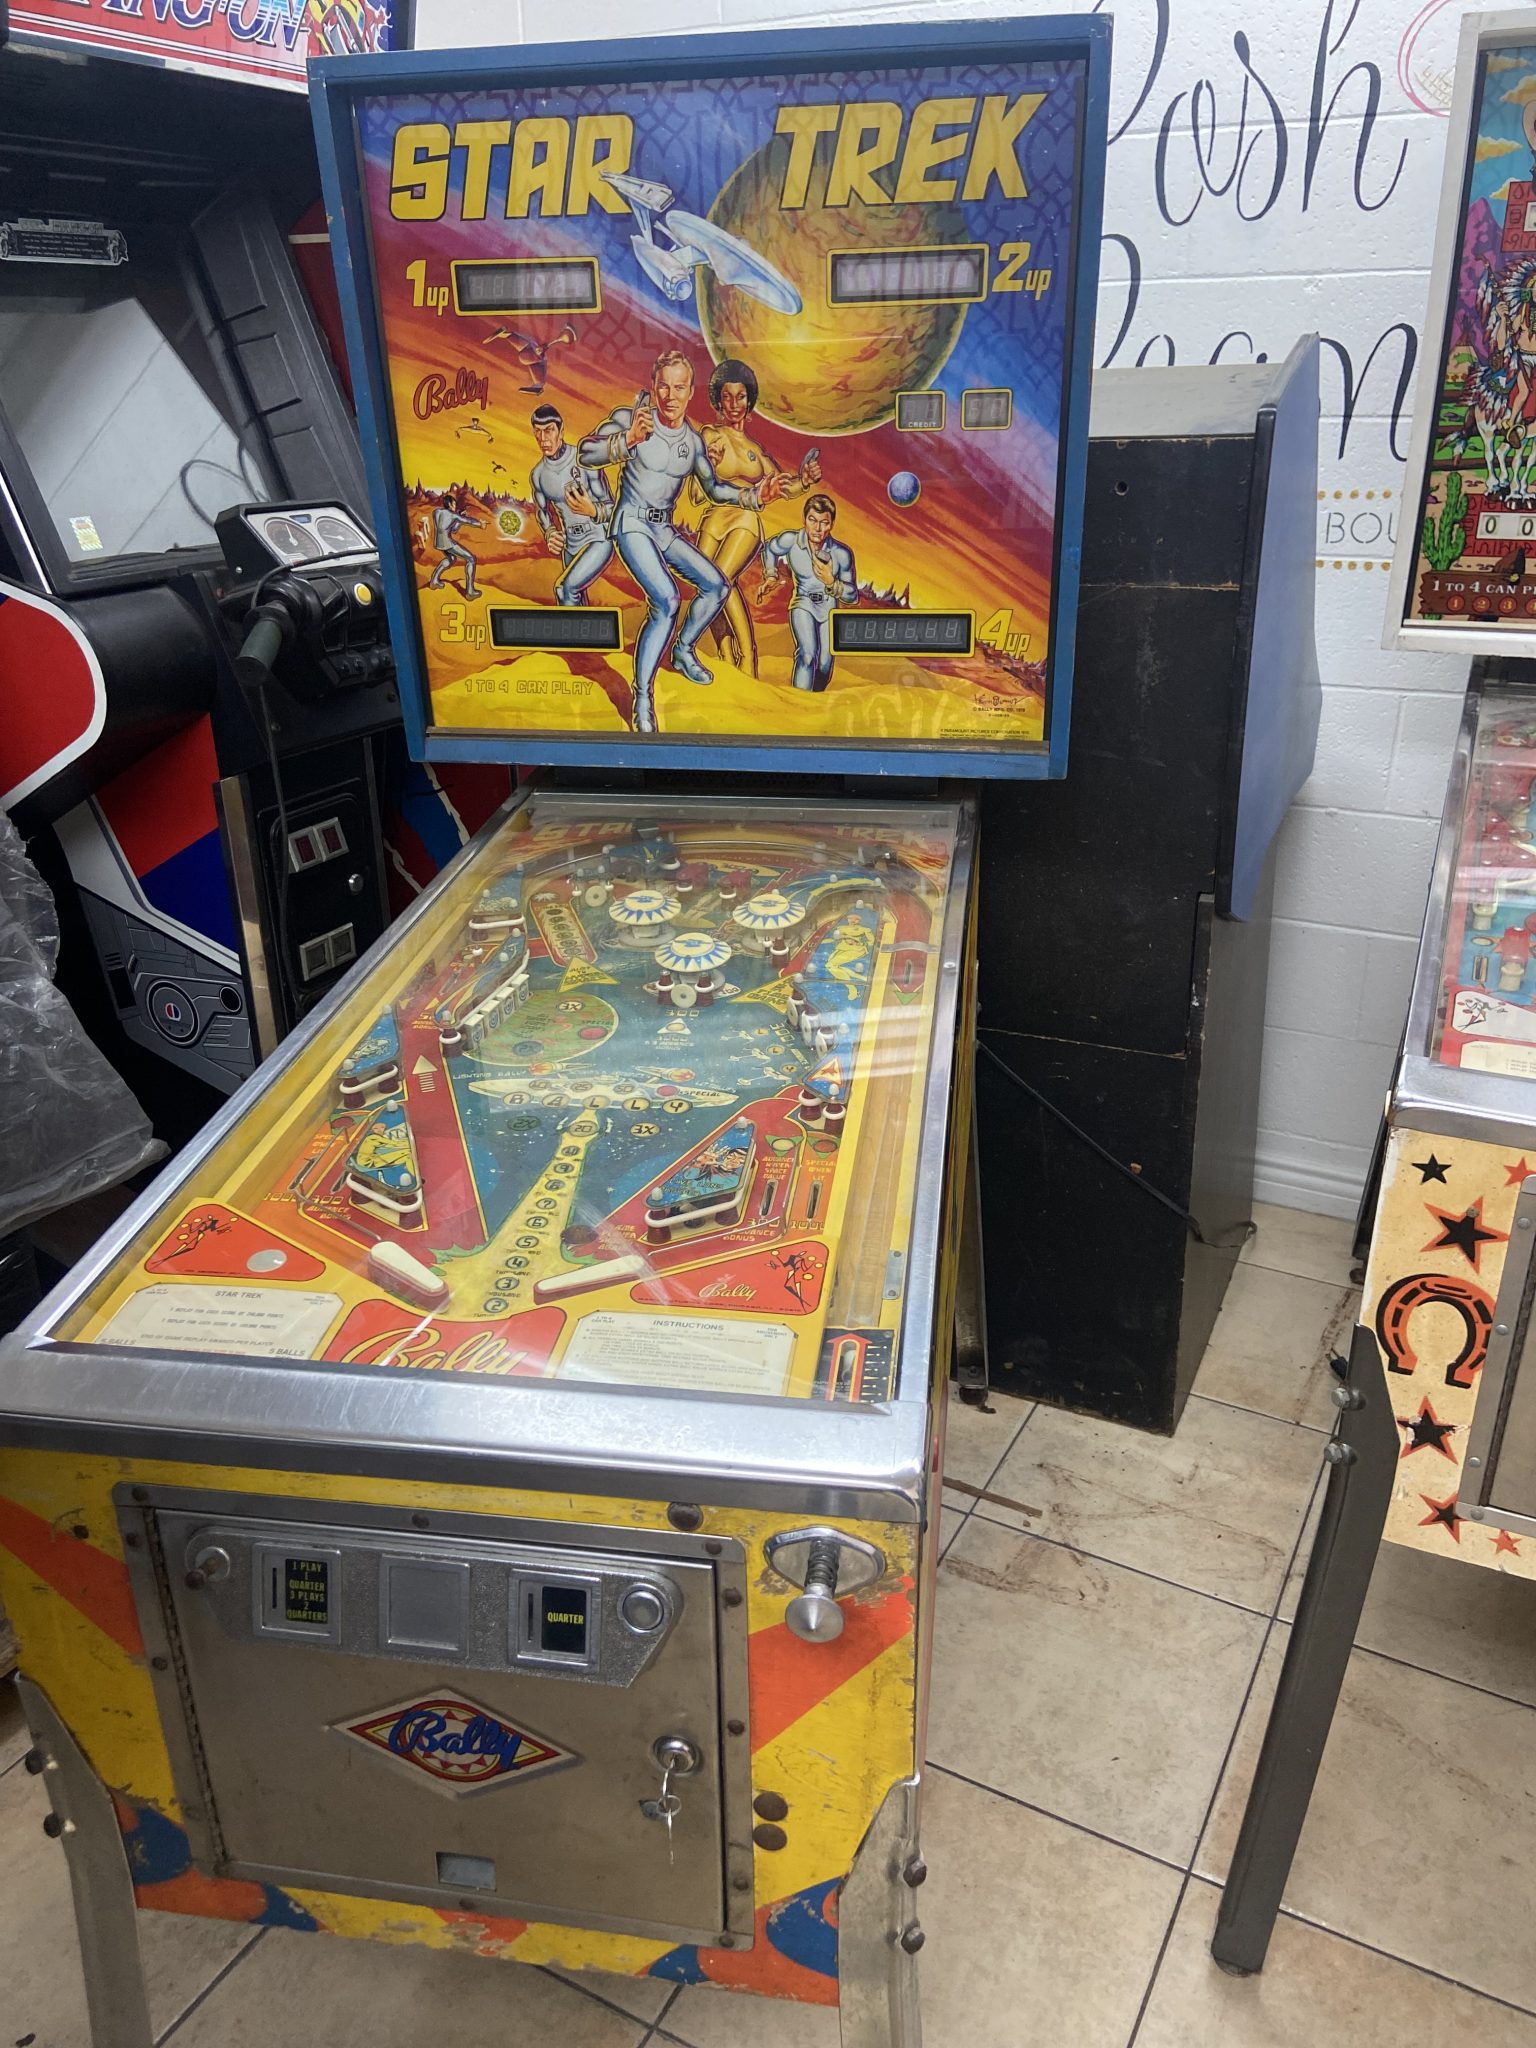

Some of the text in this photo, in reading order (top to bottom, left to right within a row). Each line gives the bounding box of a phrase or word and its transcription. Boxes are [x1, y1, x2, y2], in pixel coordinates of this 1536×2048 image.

[389, 93, 1048, 221] STAR TREK
[413, 367, 489, 420] Bally
[1432, 580, 1440, 591] 1
[1445, 582, 1465, 592] TO
[1469, 580, 1480, 592] 4
[1486, 584, 1518, 594] CAN
[465, 679, 593, 695] 1 TO 4 CAN PLAY
[833, 824, 929, 849] TREK
[633, 1125, 655, 1134] 3X
[215, 1290, 264, 1300] STAR TREK
[699, 1282, 758, 1301] Bally
[653, 1320, 724, 1331] INSTRUCTIONS
[276, 1348, 305, 1356] BALLS
[340, 1327, 527, 1375] Bally
[300, 1562, 321, 1572] PLAY
[289, 1579, 325, 1591] QUARTER
[290, 1591, 324, 1602] 3 PLAYS
[304, 1601, 309, 1610] 2
[287, 1609, 327, 1621] QUARTERS
[547, 1611, 584, 1625] QUARTER
[388, 1710, 522, 1770] Bally
